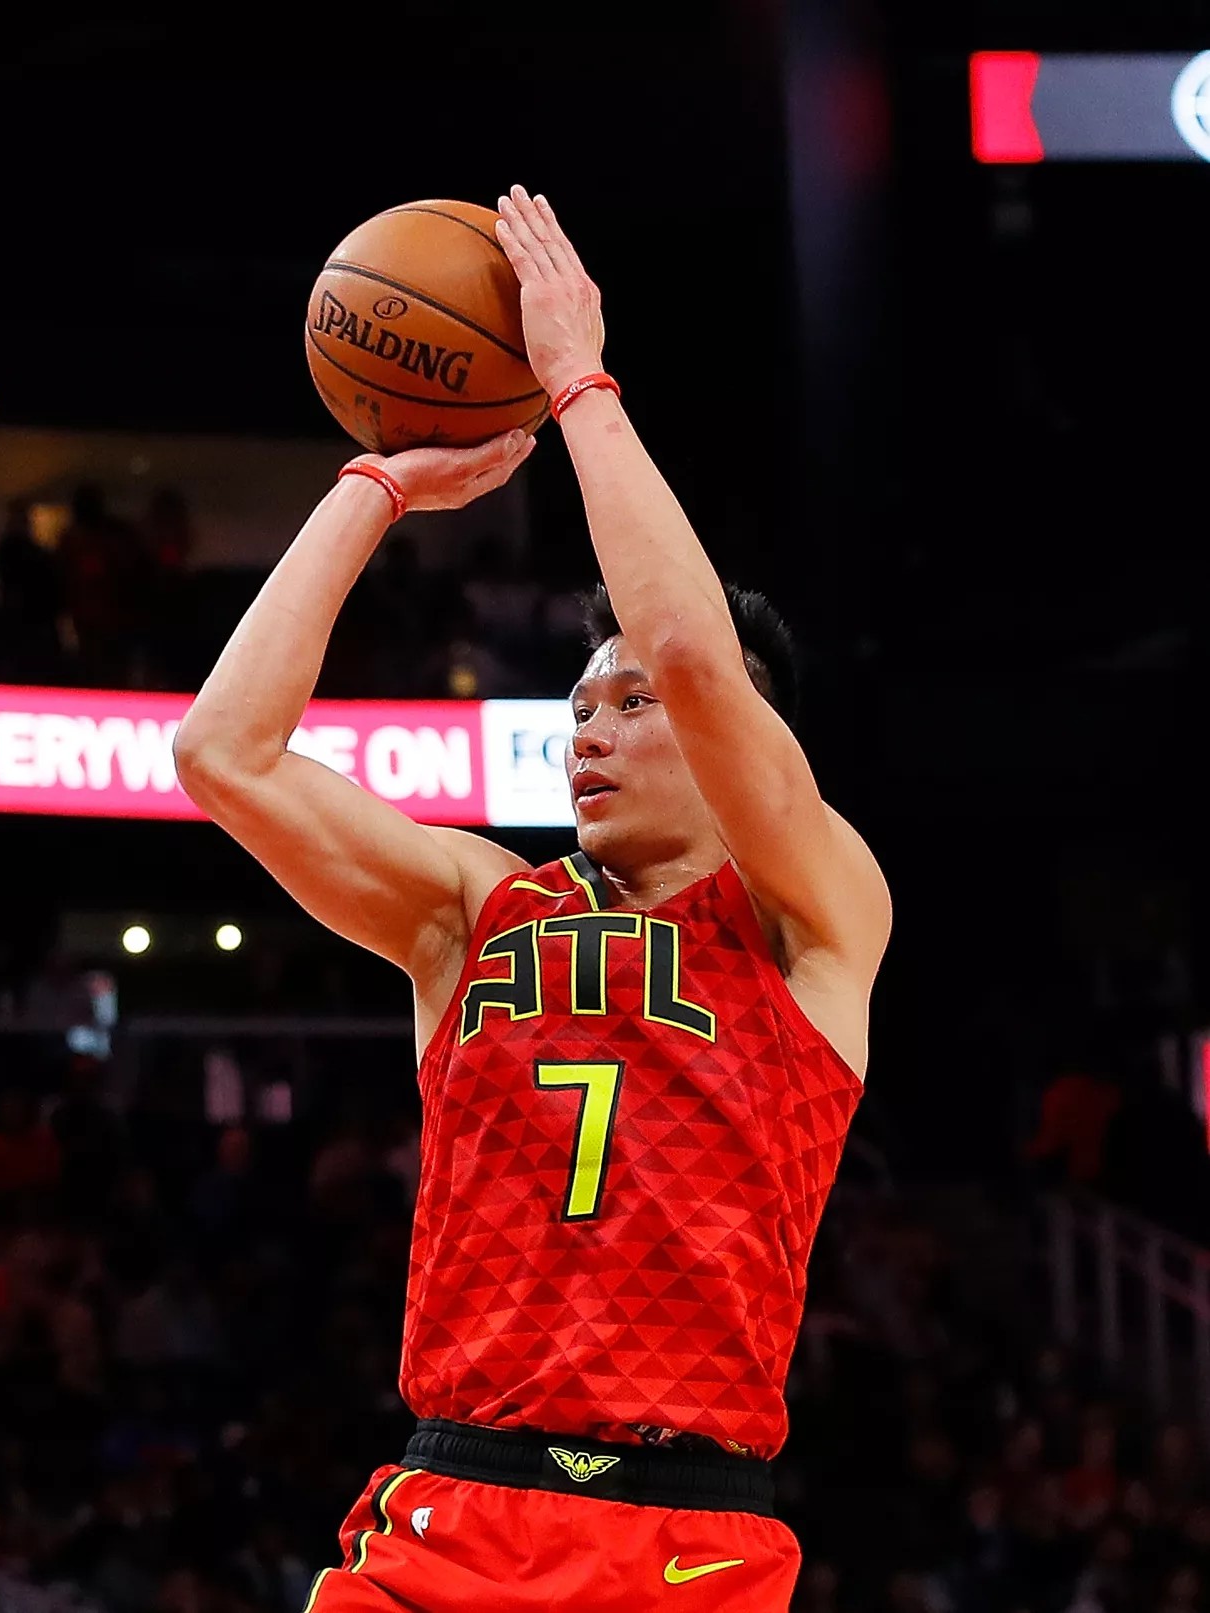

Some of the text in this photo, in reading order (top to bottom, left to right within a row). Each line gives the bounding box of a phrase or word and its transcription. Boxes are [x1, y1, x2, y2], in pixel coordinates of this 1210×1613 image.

[313, 290, 475, 396] SPALDING
[364, 726, 474, 800] ON
[459, 911, 717, 1047] ATL
[533, 1058, 626, 1224] 7
